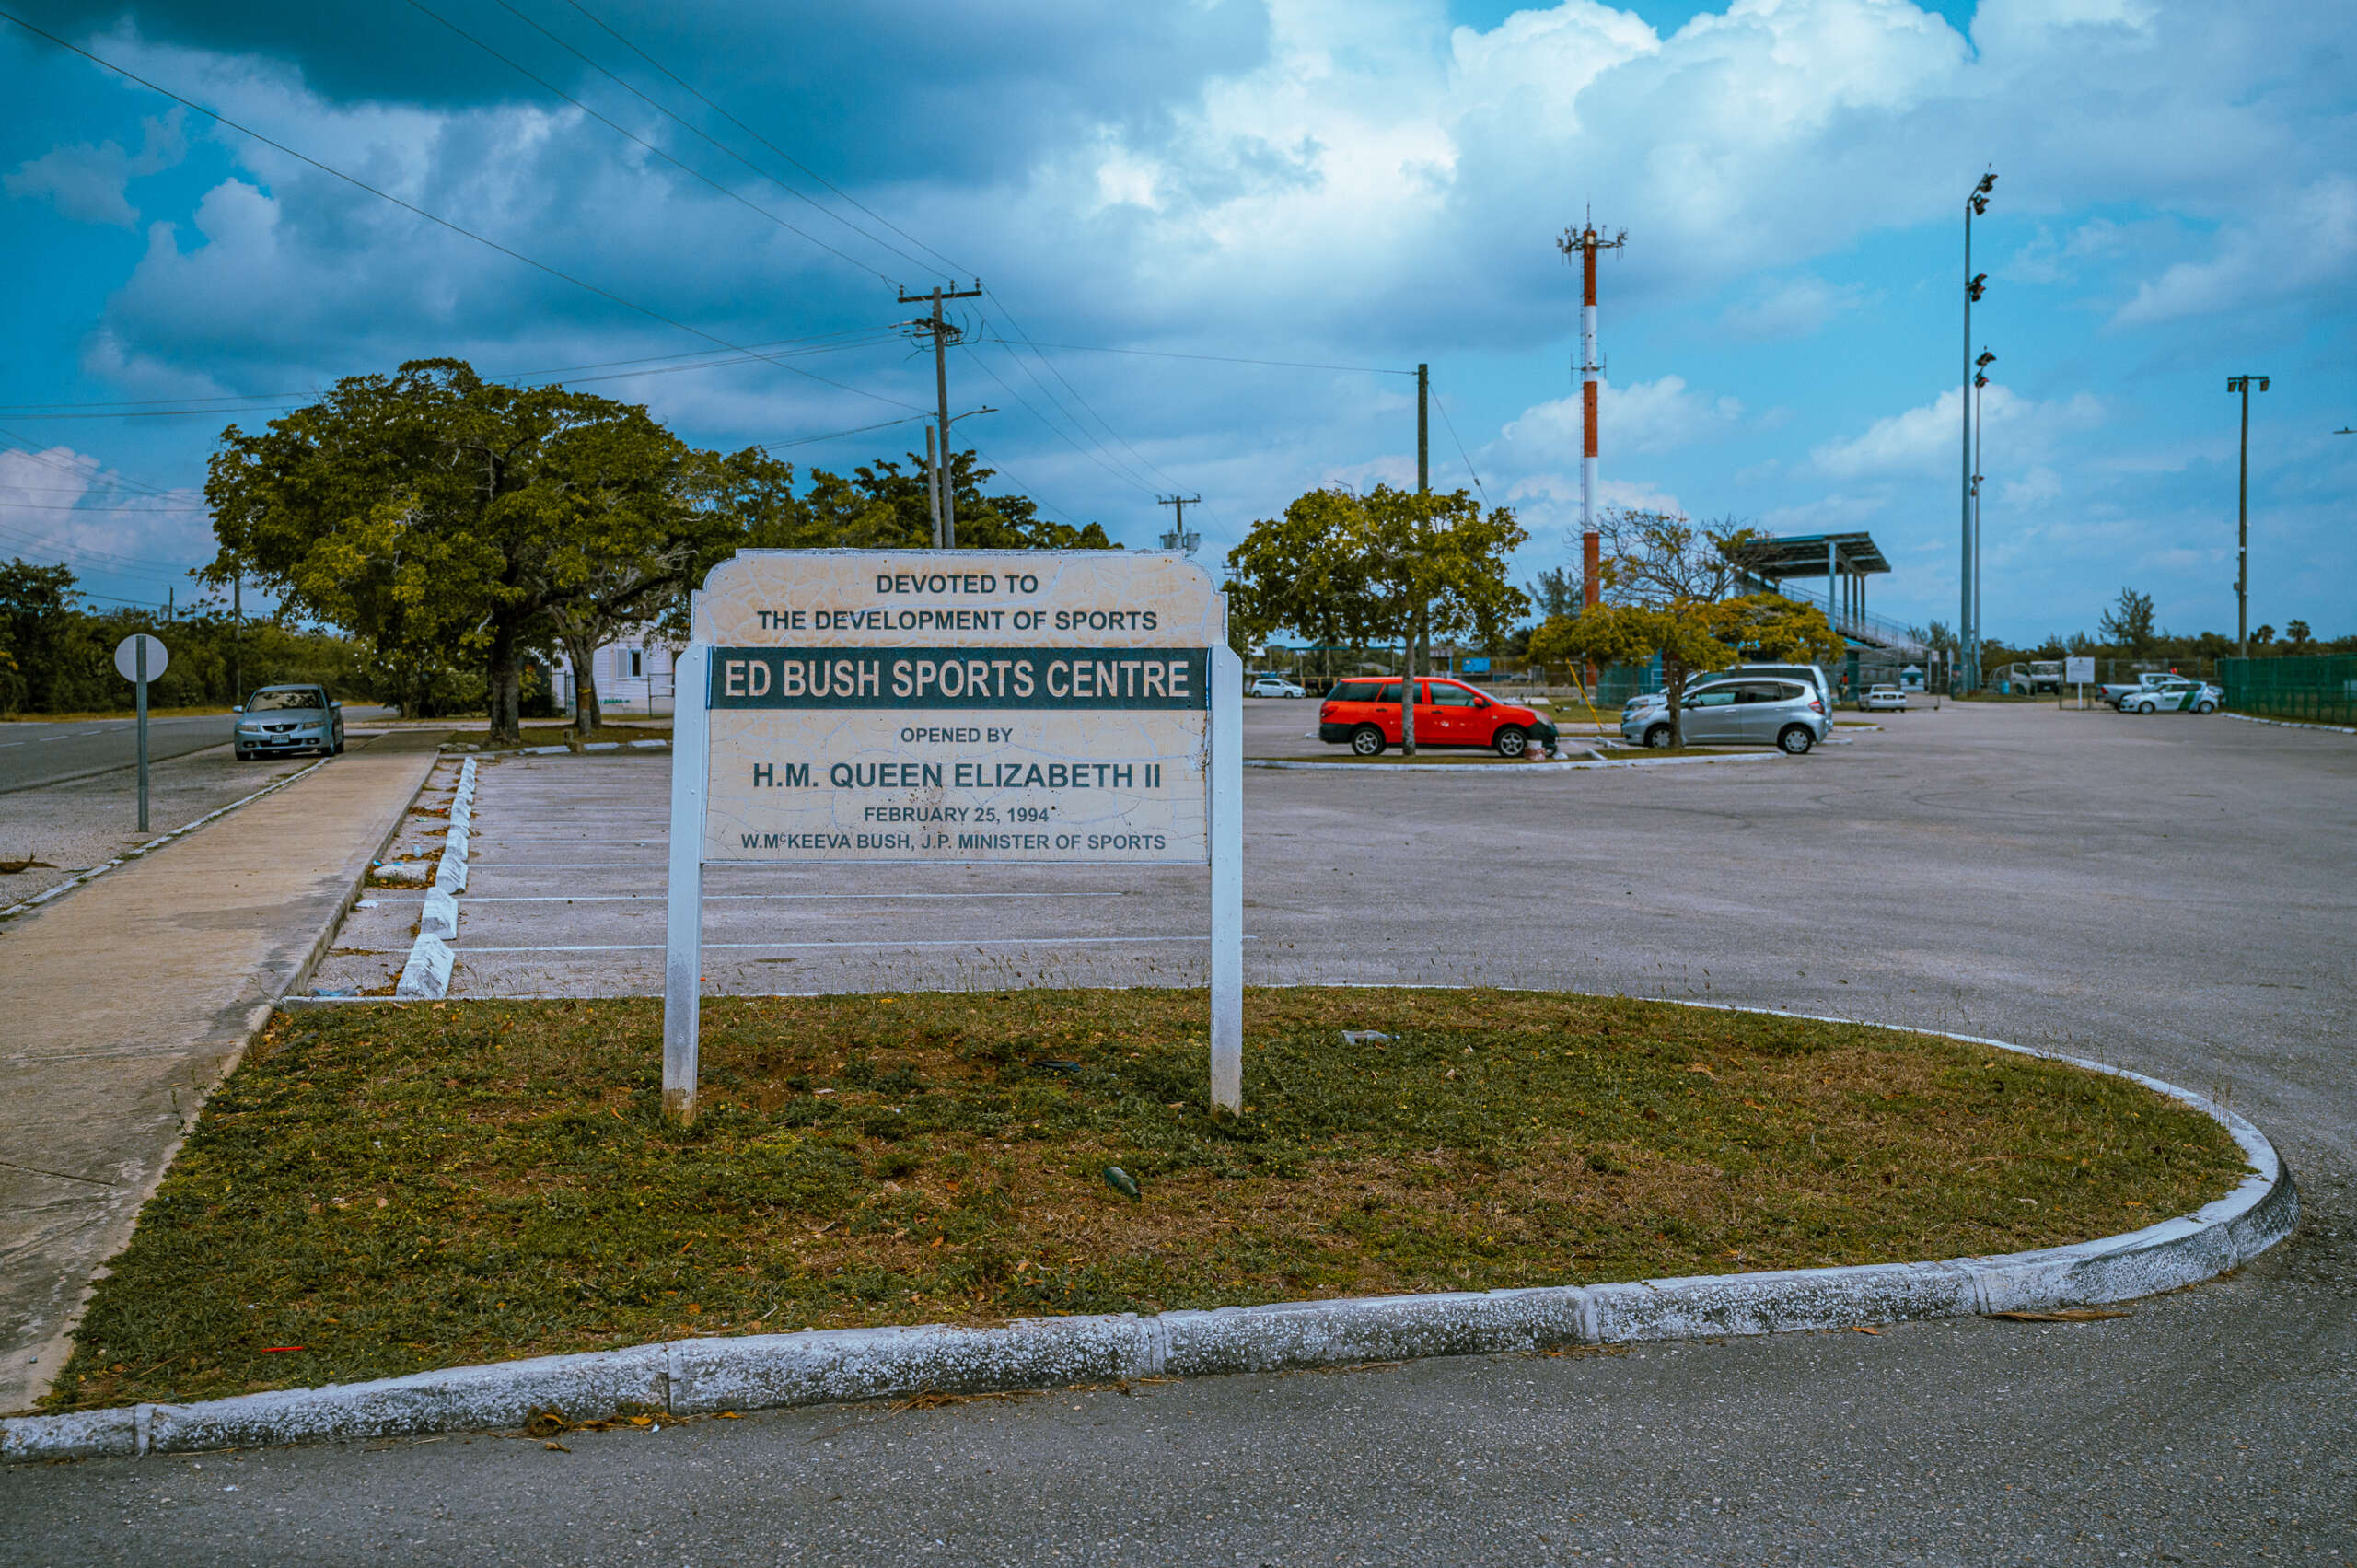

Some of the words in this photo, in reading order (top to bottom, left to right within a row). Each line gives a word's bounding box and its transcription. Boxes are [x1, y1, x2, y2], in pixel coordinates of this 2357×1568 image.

[876, 574, 997, 594] DEVOTED
[1004, 574, 1039, 594] TO
[756, 610, 807, 631] THE
[815, 610, 1005, 631] DEVELOPMENT
[1013, 610, 1047, 631] OF
[1054, 610, 1158, 631] SPORTS
[725, 660, 772, 697] ED
[784, 659, 880, 697] BUSH
[891, 659, 1035, 698] SPORTS
[1046, 659, 1190, 698] CENTRE
[900, 727, 981, 743] OPENED
[987, 727, 1014, 743] BY
[753, 762, 819, 788] H.M.
[830, 762, 944, 790] QUEEN
[954, 762, 1133, 788] ELIZABETH
[1144, 763, 1161, 789] II
[865, 807, 970, 823] FEBRUARY
[974, 807, 1001, 826] 25,
[1006, 807, 1050, 823] 1994
[856, 833, 915, 852] BUSH,
[921, 833, 952, 850] J.P.
[958, 833, 1050, 850] MINISTER
[1055, 834, 1082, 850] OF
[1087, 834, 1166, 850] SPORTS
